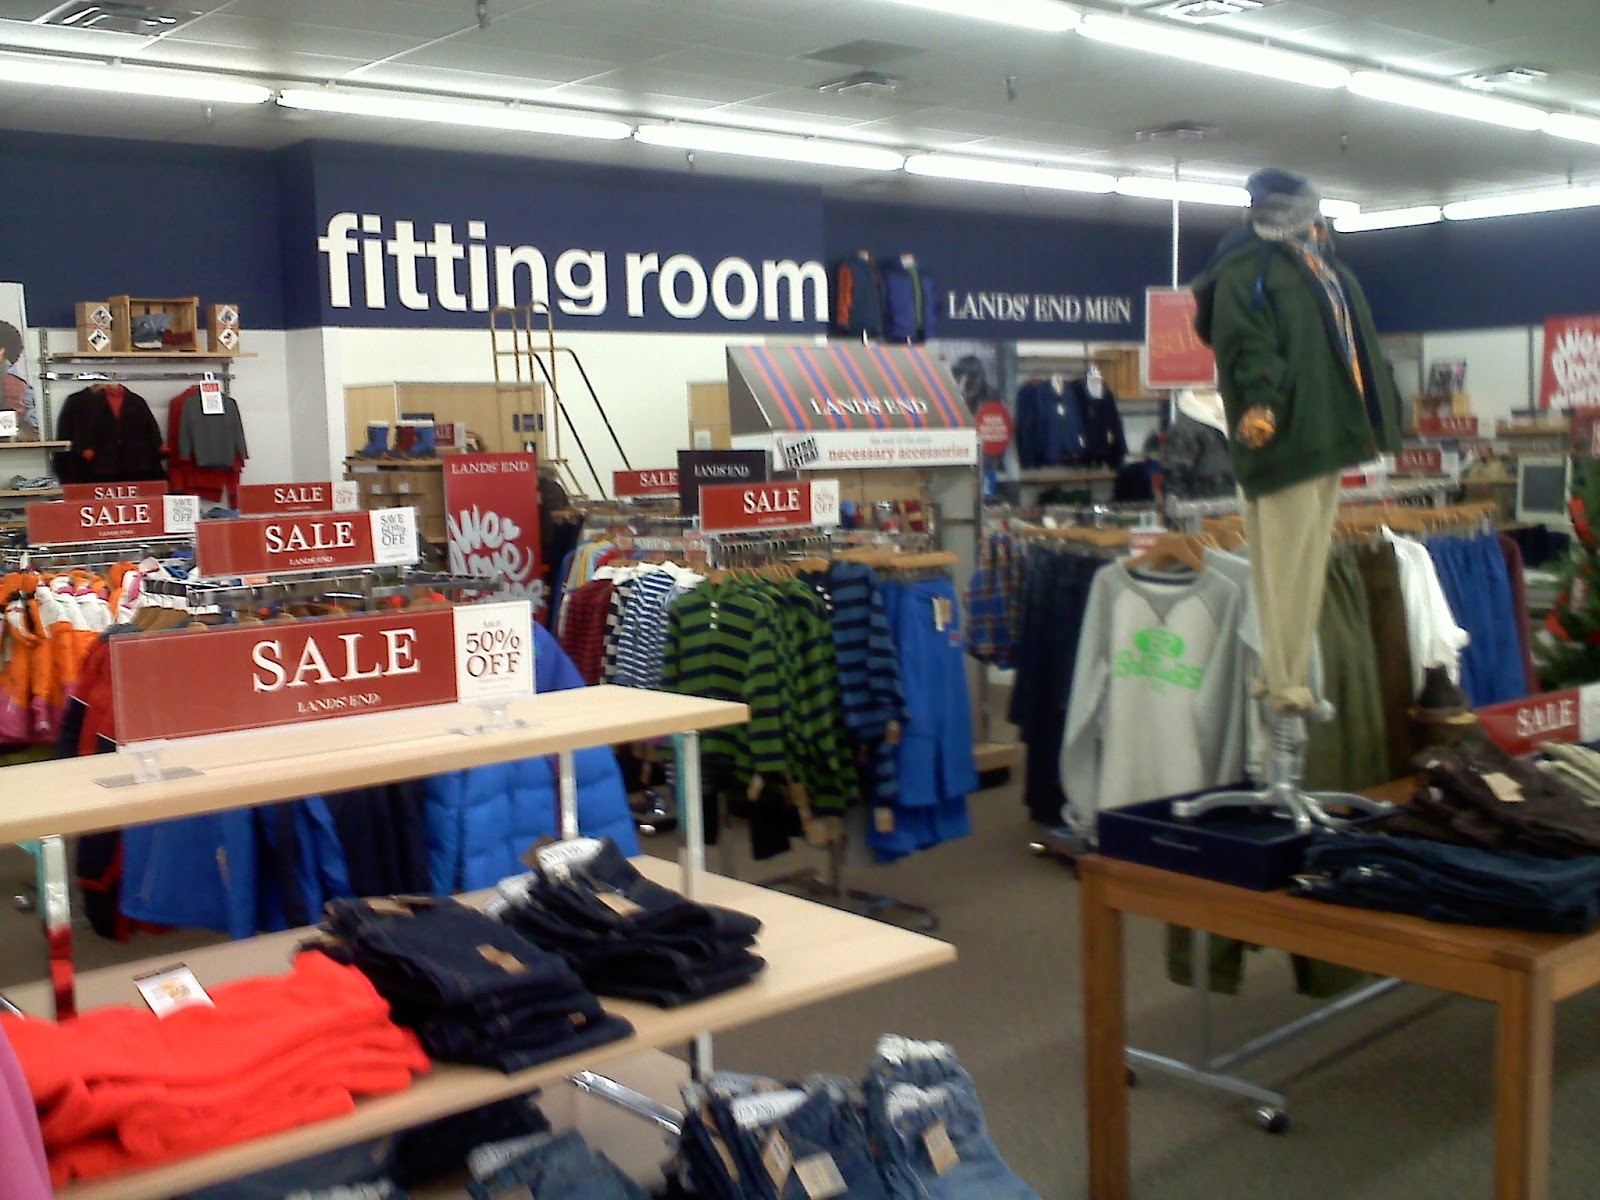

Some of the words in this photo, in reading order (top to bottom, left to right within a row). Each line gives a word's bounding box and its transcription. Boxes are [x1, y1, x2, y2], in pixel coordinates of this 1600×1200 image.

[318, 212, 608, 317] fitting
[624, 251, 830, 323] room
[1033, 296, 1081, 323] END
[1085, 297, 1133, 325] MEN
[883, 397, 928, 415] END
[501, 461, 529, 474] END
[828, 448, 896, 465] necessary
[898, 445, 970, 460] accessories
[640, 470, 679, 487] SALE
[94, 485, 138, 500] SALE
[274, 487, 323, 504] SALE
[743, 488, 800, 515] SALE
[80, 503, 151, 528] SALE
[265, 521, 355, 554] SALE
[382, 533, 405, 546] OFF
[466, 628, 520, 653] 50%
[252, 628, 421, 693] SALE
[467, 652, 520, 677] OFF
[349, 693, 381, 707] END
[1517, 699, 1575, 737] SALE
